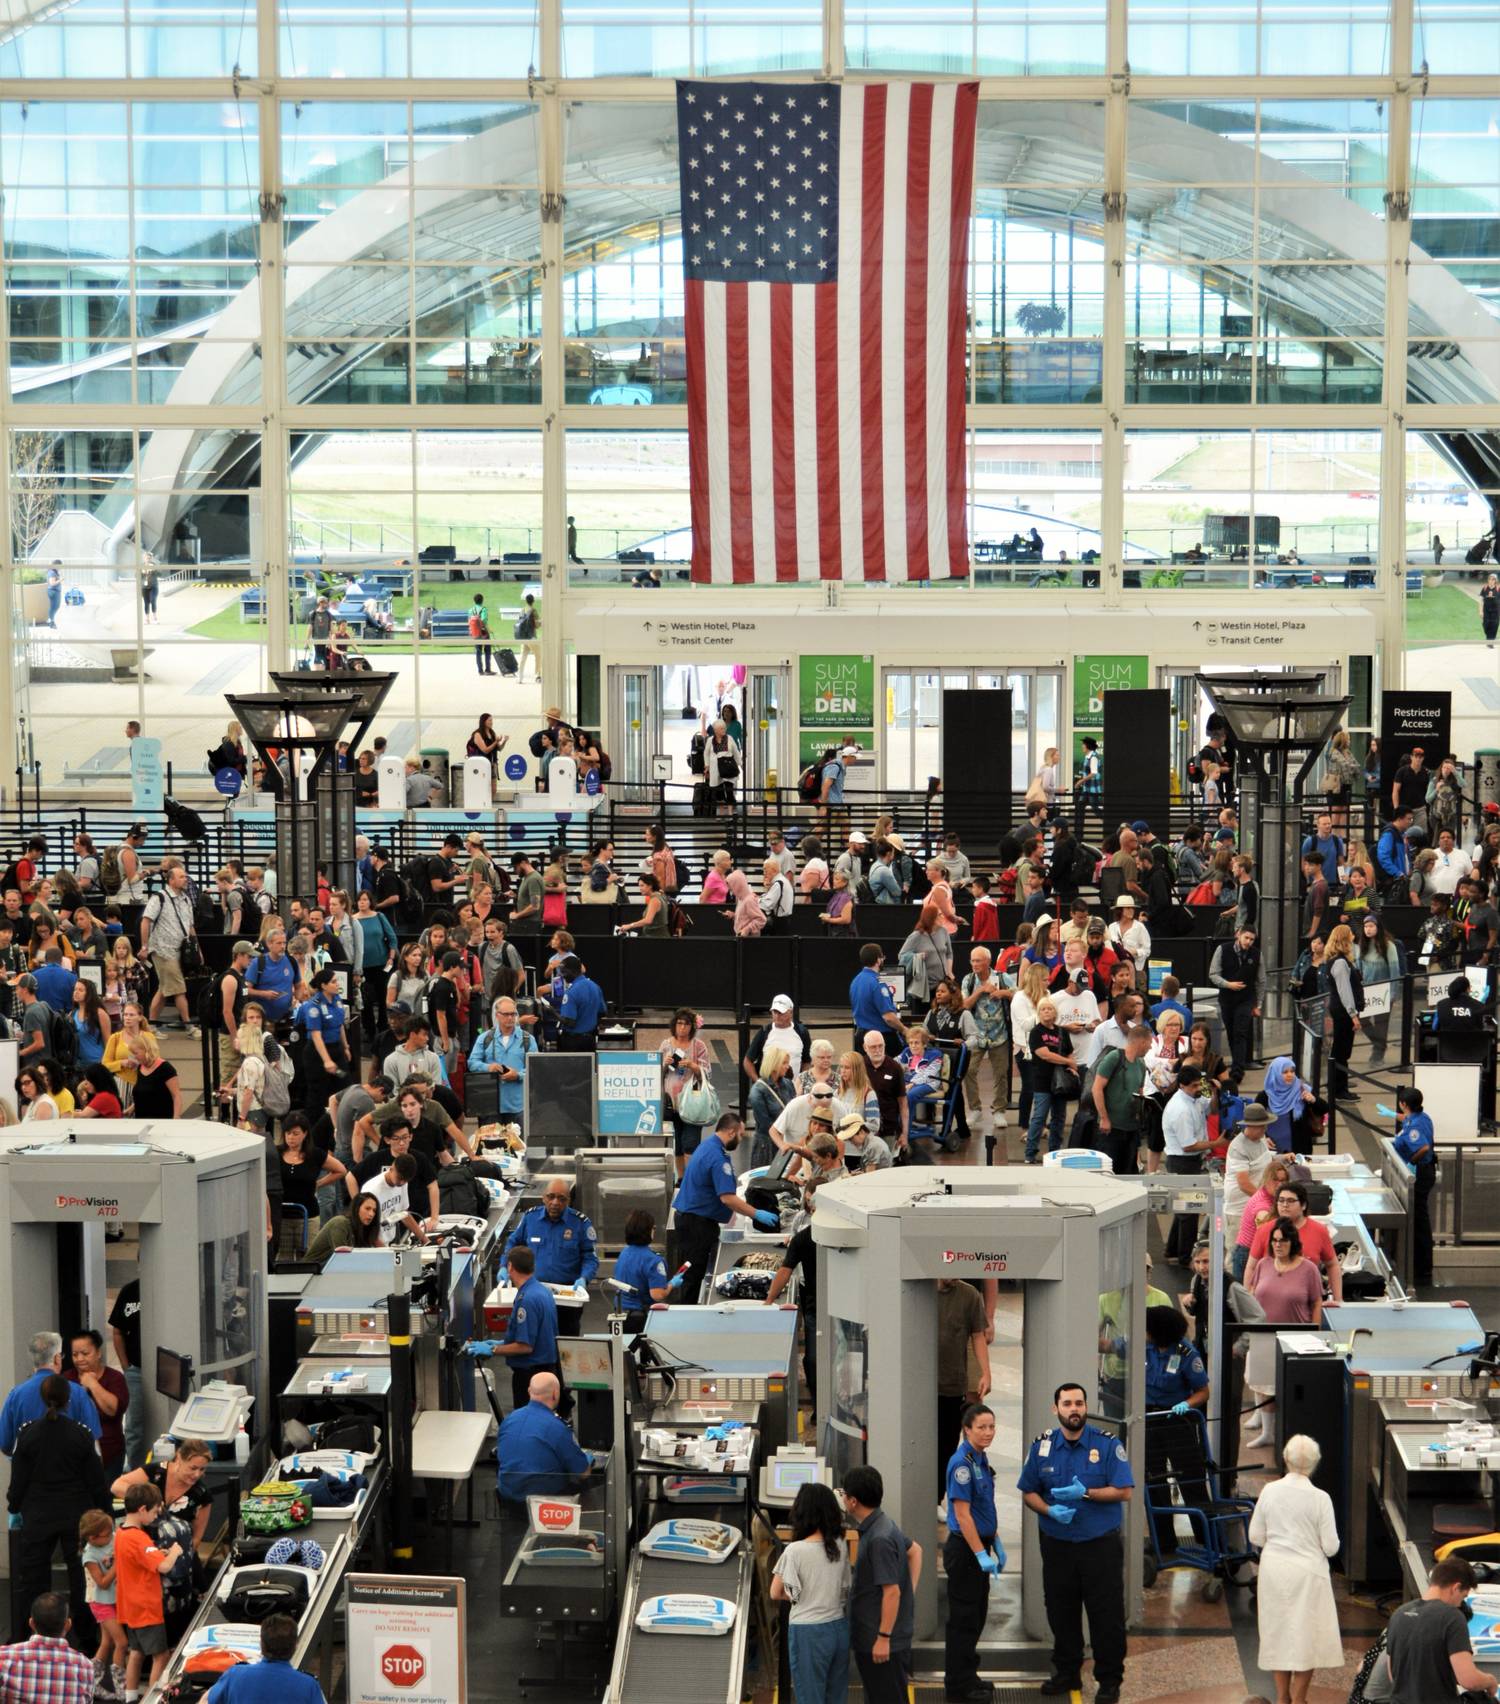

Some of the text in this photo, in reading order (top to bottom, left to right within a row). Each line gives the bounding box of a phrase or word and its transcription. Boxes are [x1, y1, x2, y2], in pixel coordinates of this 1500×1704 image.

[670, 622, 756, 631] Westin Hotel, Plaza
[1220, 621, 1306, 630] Westin Hotel, Plaza
[671, 636, 734, 645] Transit Center
[1220, 636, 1284, 644] Transit Center
[815, 663, 857, 680] SUM
[1089, 663, 1132, 680] SUM
[815, 681, 857, 697] MER
[815, 698, 856, 713] DEN
[1393, 707, 1441, 717] Restricted
[1401, 719, 1433, 728] Access
[1452, 1007, 1471, 1017] TSA
[603, 1077, 655, 1087] HOLD IT
[603, 1088, 655, 1098] REFILL IT
[68, 1197, 118, 1206] ProVision
[97, 1207, 119, 1216] ATD
[395, 1252, 401, 1265] 5
[957, 1252, 1007, 1261] ProVision
[983, 1262, 1007, 1271] ATD
[613, 1322, 620, 1336] 6
[543, 1509, 570, 1520] STOP
[354, 1586, 374, 1594] Notice
[382, 1588, 413, 1596] Additional
[414, 1590, 444, 1598] Screening
[384, 1657, 423, 1674] STOP
[378, 1695, 399, 1703] safety
